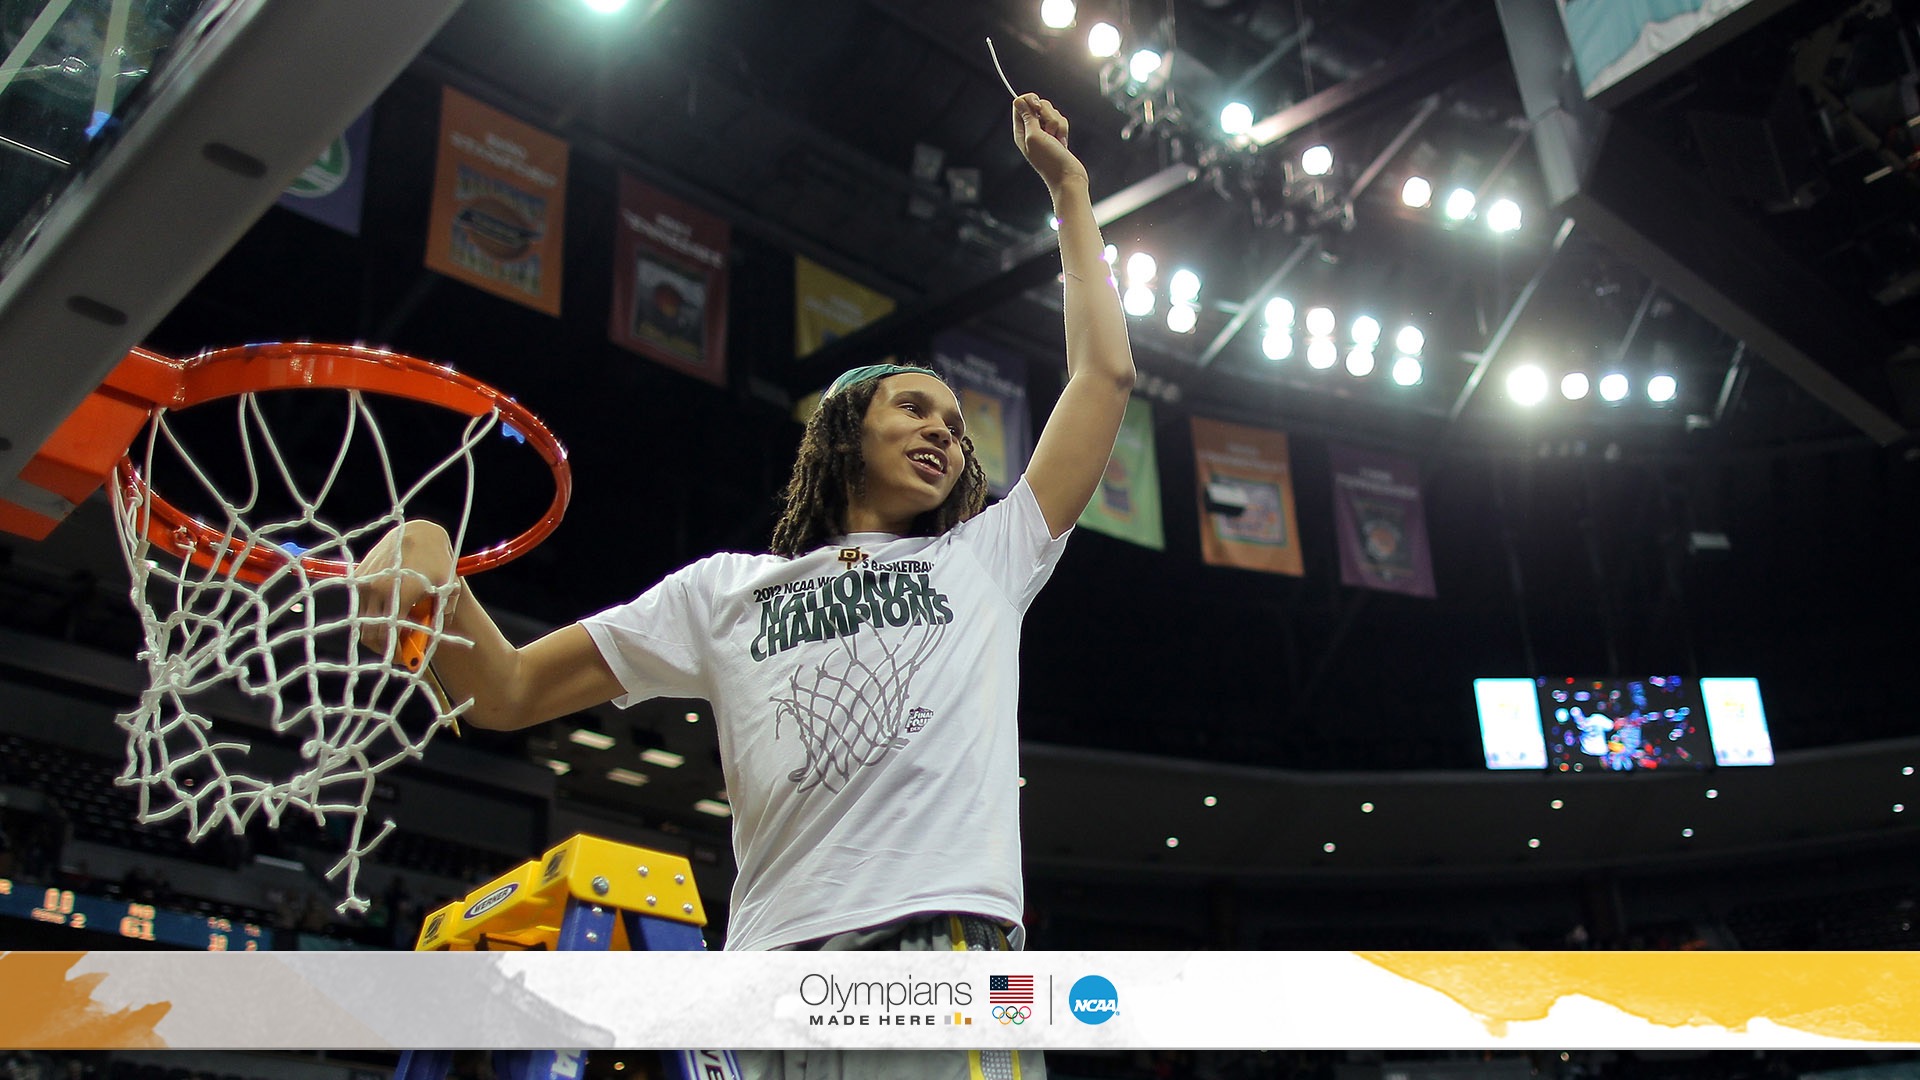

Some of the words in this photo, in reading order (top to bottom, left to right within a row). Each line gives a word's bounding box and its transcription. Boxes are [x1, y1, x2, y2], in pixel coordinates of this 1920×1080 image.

[753, 585, 781, 602] 2012
[783, 579, 815, 593] NCAA
[872, 560, 935, 574] BASKETBA
[761, 569, 936, 633] NATIONAL
[750, 594, 955, 662] CHAMPIONS
[473, 888, 509, 913] WERNER
